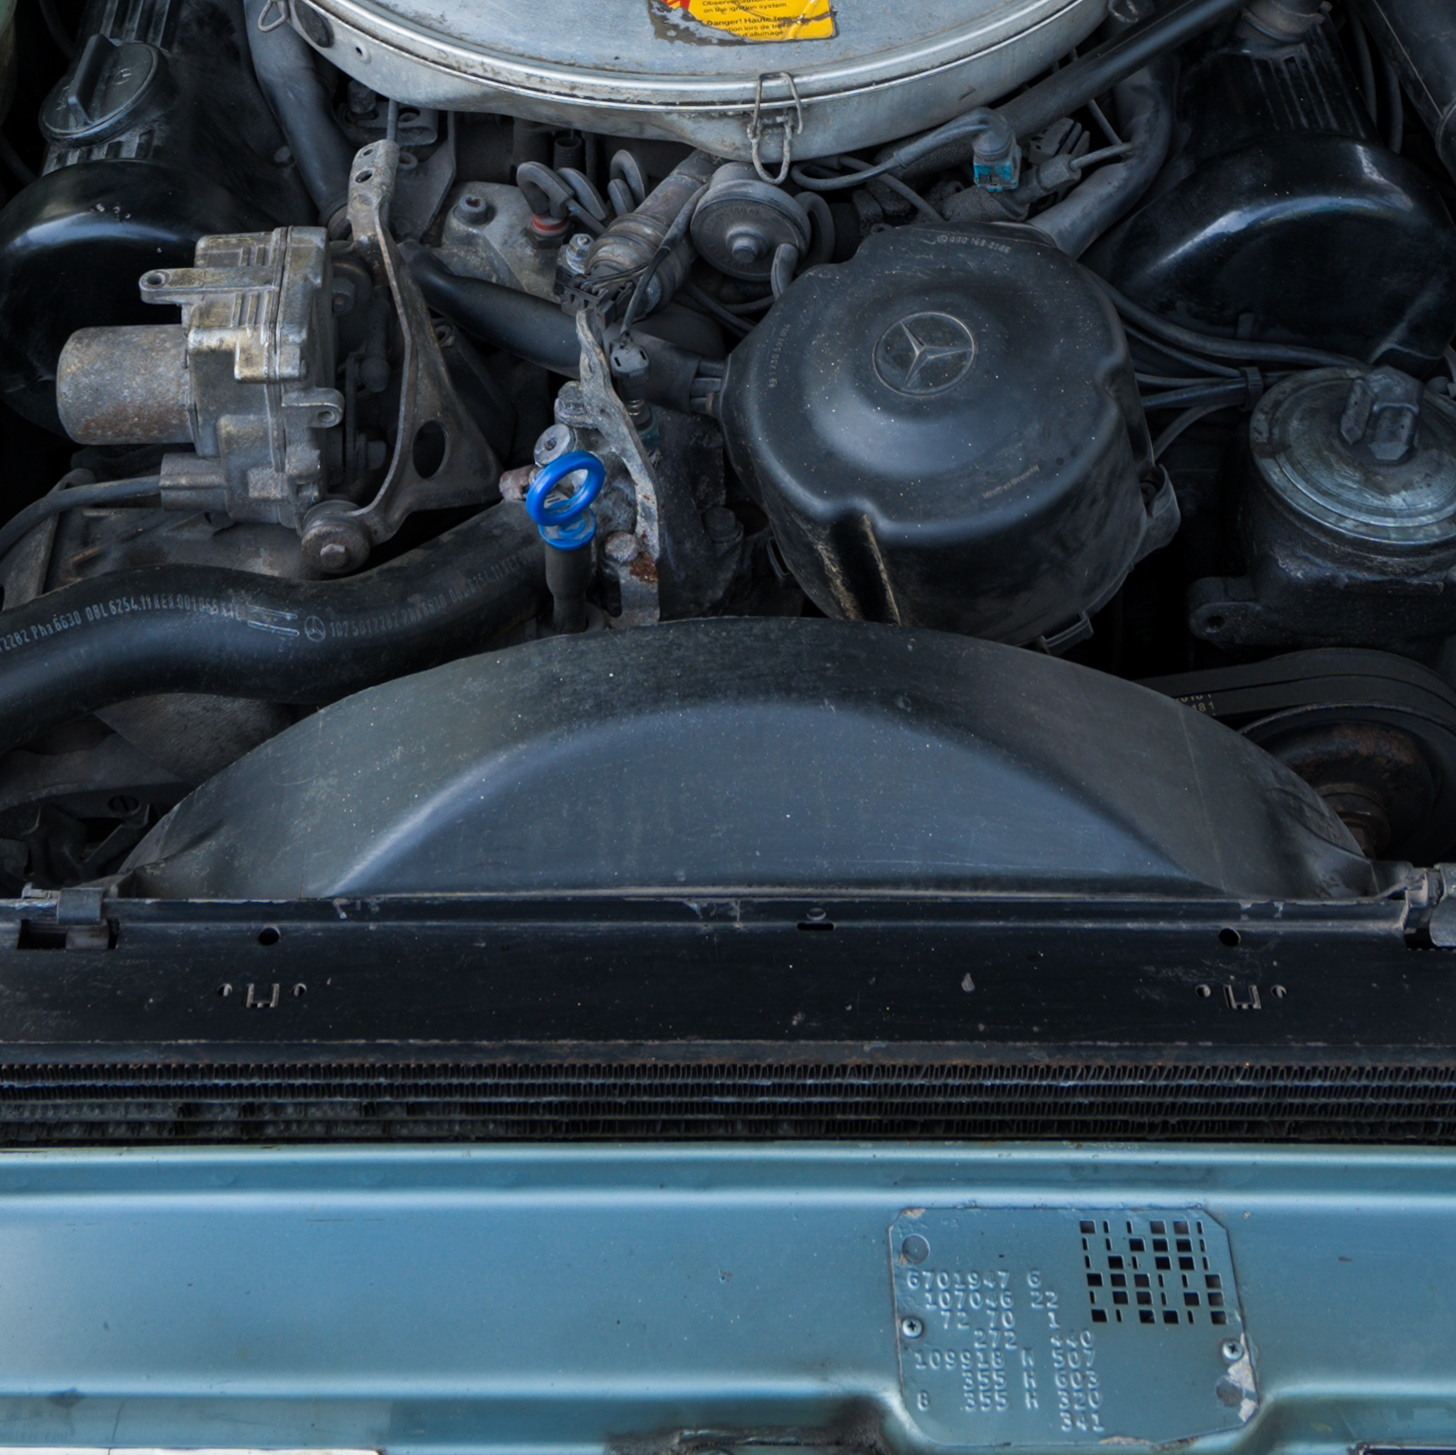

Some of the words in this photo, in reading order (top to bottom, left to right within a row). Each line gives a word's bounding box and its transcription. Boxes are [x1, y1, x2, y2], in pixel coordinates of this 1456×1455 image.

[759, 2, 787, 11] system
[906, 1269, 1010, 1291] 6701947
[1028, 1269, 1042, 1289] 6
[925, 1290, 1014, 1311] 107046
[1030, 1290, 1059, 1311] 22
[940, 1310, 970, 1330] 72
[986, 1309, 1015, 1330] 70
[1047, 1310, 1061, 1330] 1
[974, 1329, 1018, 1351] 272
[913, 1349, 1006, 1372] 109918
[1051, 1348, 1096, 1370] 507
[962, 1371, 1008, 1392] 355
[963, 1391, 1010, 1413] 355
[1057, 1390, 1103, 1411] 320
[1059, 1411, 1106, 1434] 341
